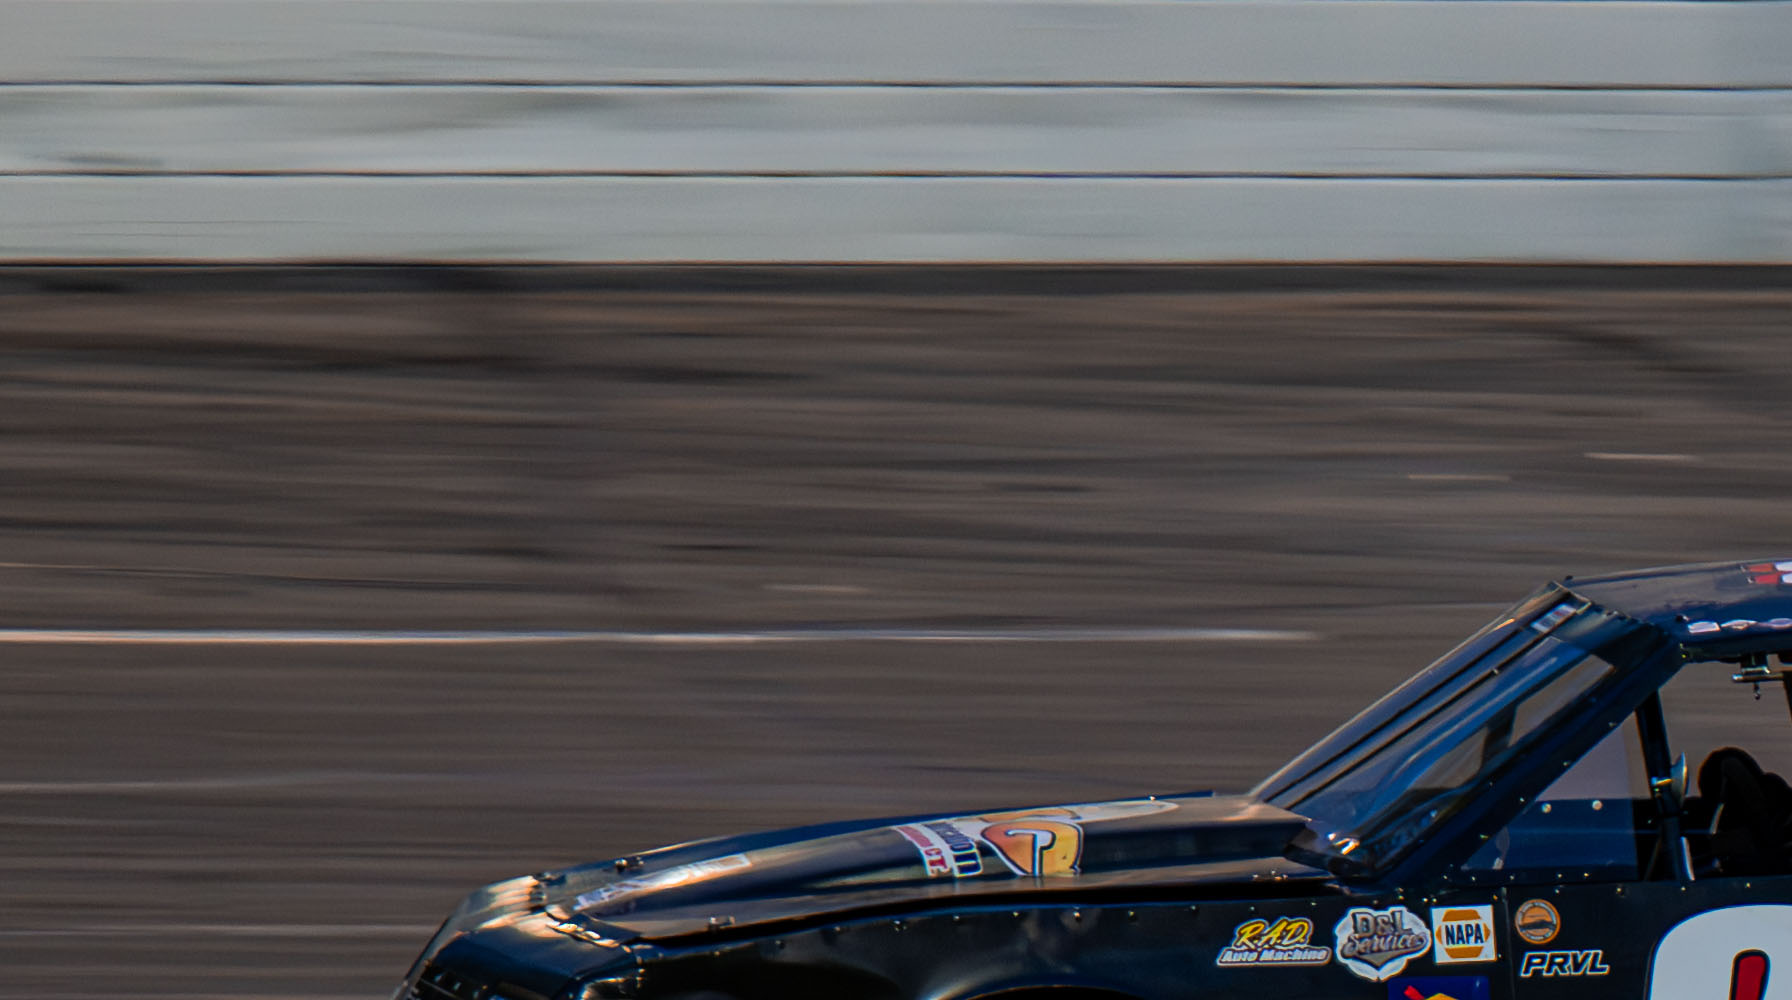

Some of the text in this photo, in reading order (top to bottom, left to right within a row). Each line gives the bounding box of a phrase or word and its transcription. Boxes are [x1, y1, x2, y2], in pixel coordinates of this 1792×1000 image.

[1351, 911, 1414, 937] D&L
[1444, 923, 1485, 946] NAPA
[1221, 949, 1328, 962] Auto Machine
[1521, 950, 1610, 977] PRVL
